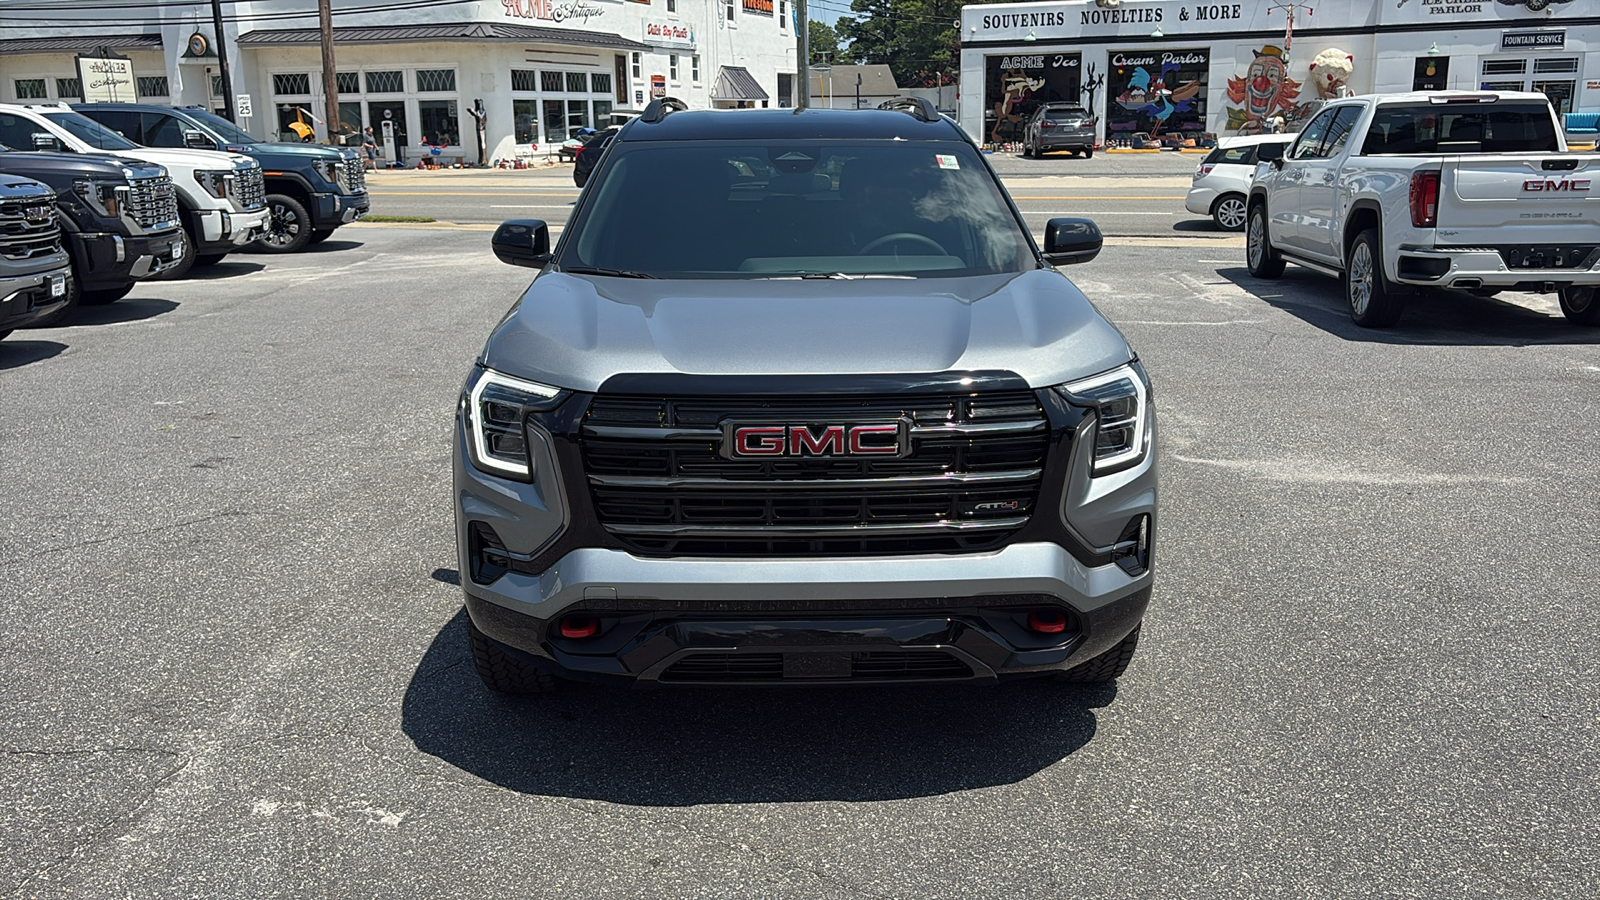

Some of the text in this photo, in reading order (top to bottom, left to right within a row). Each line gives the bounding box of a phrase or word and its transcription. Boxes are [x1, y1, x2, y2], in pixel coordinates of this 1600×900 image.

[501, 0, 605, 24] ACME Antiques
[983, 4, 1241, 29] SOUVENIRS NOVELTIES & MORE
[1429, 4, 1482, 15] PARLOR
[647, 22, 688, 40] Dutch Boy Paints
[1504, 34, 1563, 45] FOUNTAIN SERVICE
[1000, 54, 1079, 69] ACME Ice
[1112, 51, 1206, 66] Cream Parlor
[239, 105, 251, 115] 25
[1523, 179, 1591, 192] GMC
[735, 424, 899, 456] GMC
[974, 501, 1018, 510] AT4
